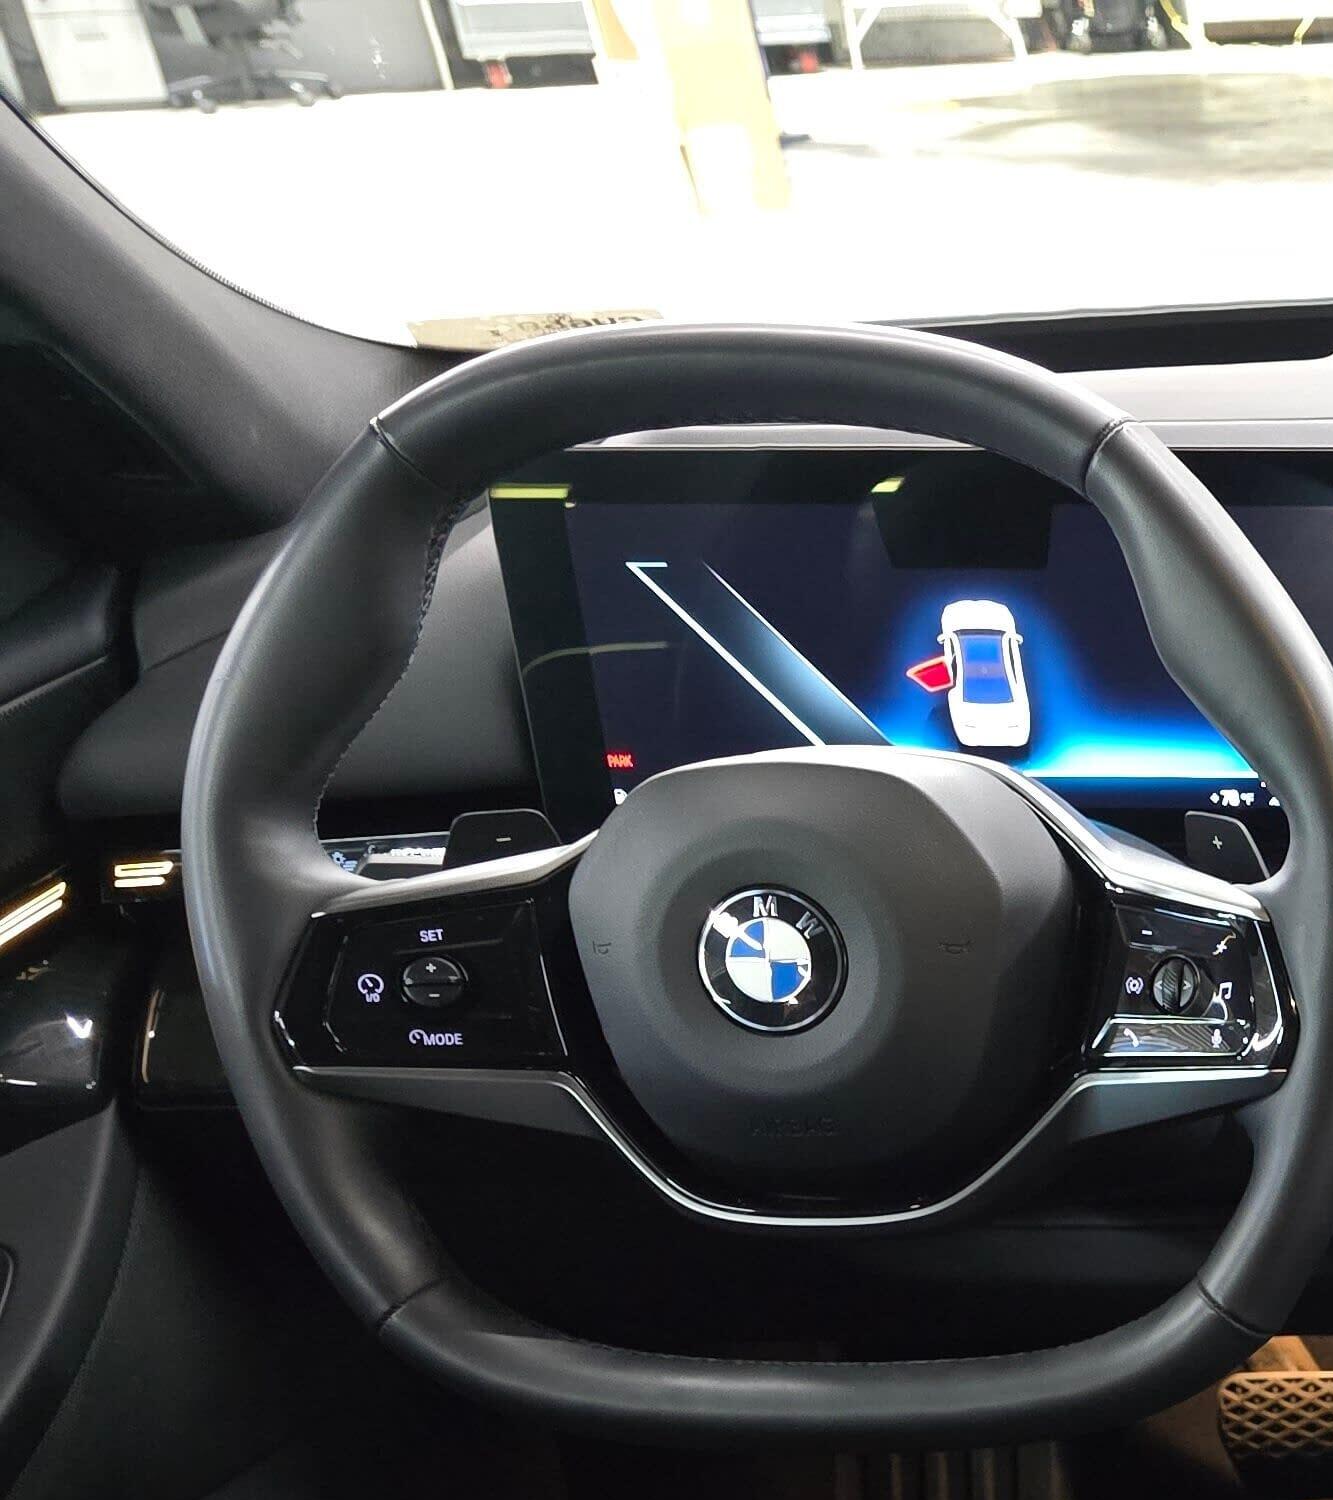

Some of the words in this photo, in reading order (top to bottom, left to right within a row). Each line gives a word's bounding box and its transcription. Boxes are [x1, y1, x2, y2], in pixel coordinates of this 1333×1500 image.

[606, 753, 634, 769] PARK
[419, 928, 444, 943] SET
[423, 1032, 464, 1046] MODE
